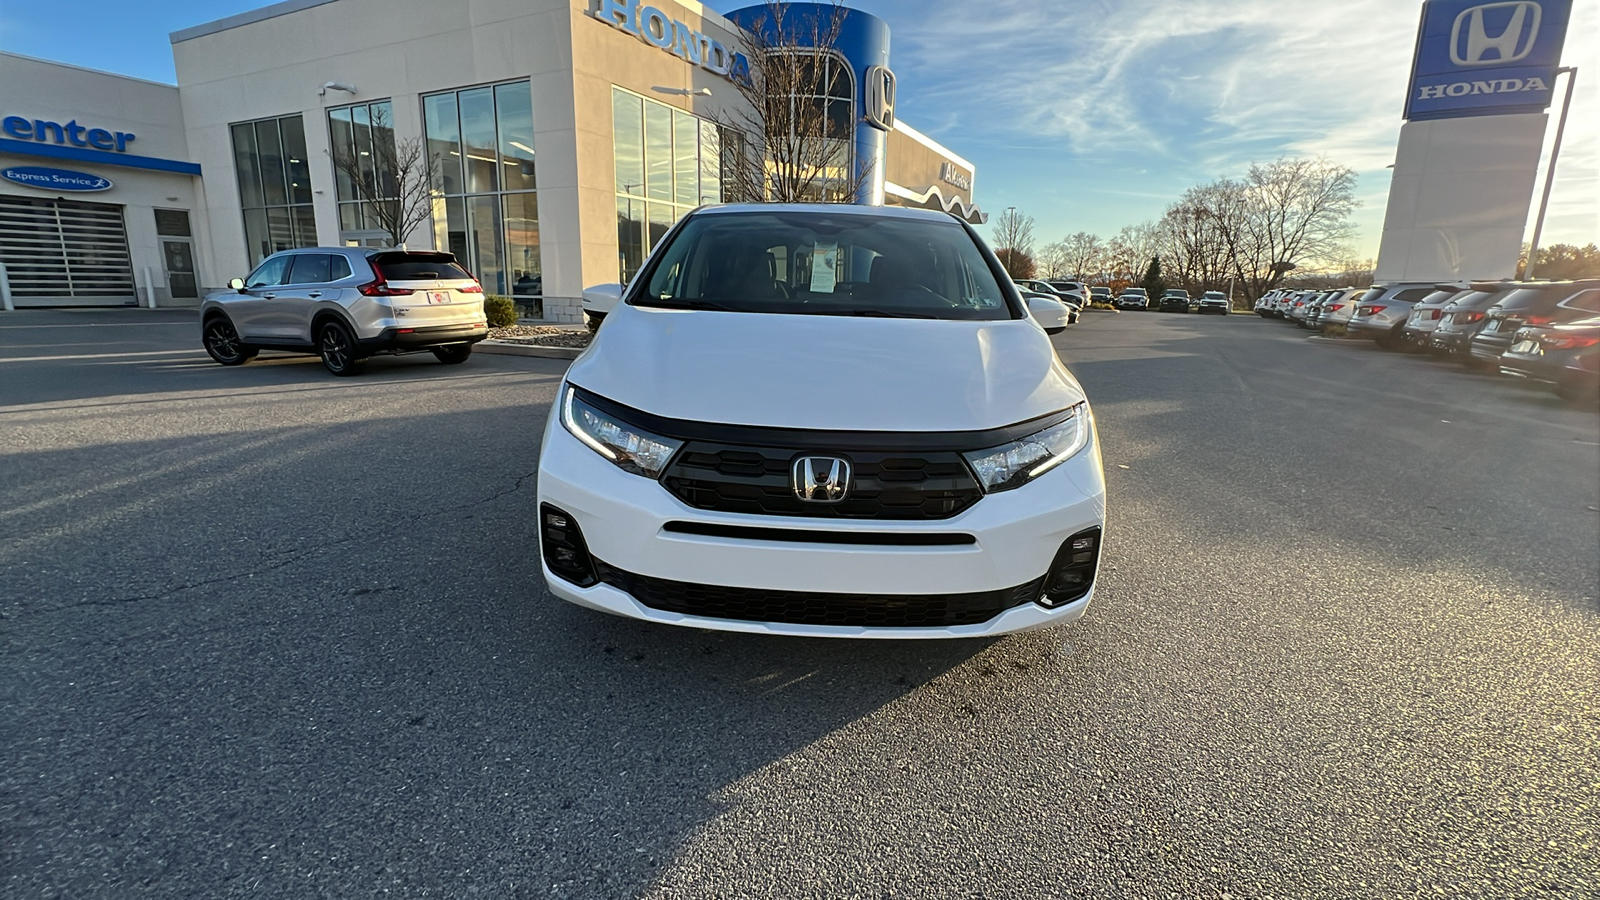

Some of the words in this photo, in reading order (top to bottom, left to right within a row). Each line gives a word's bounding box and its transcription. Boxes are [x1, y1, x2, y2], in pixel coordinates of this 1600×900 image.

[584, 0, 755, 89] HONDA
[1418, 77, 1548, 100] HONDA
[2, 115, 136, 152] enter
[6, 170, 50, 182] Express
[52, 175, 91, 186] Service
